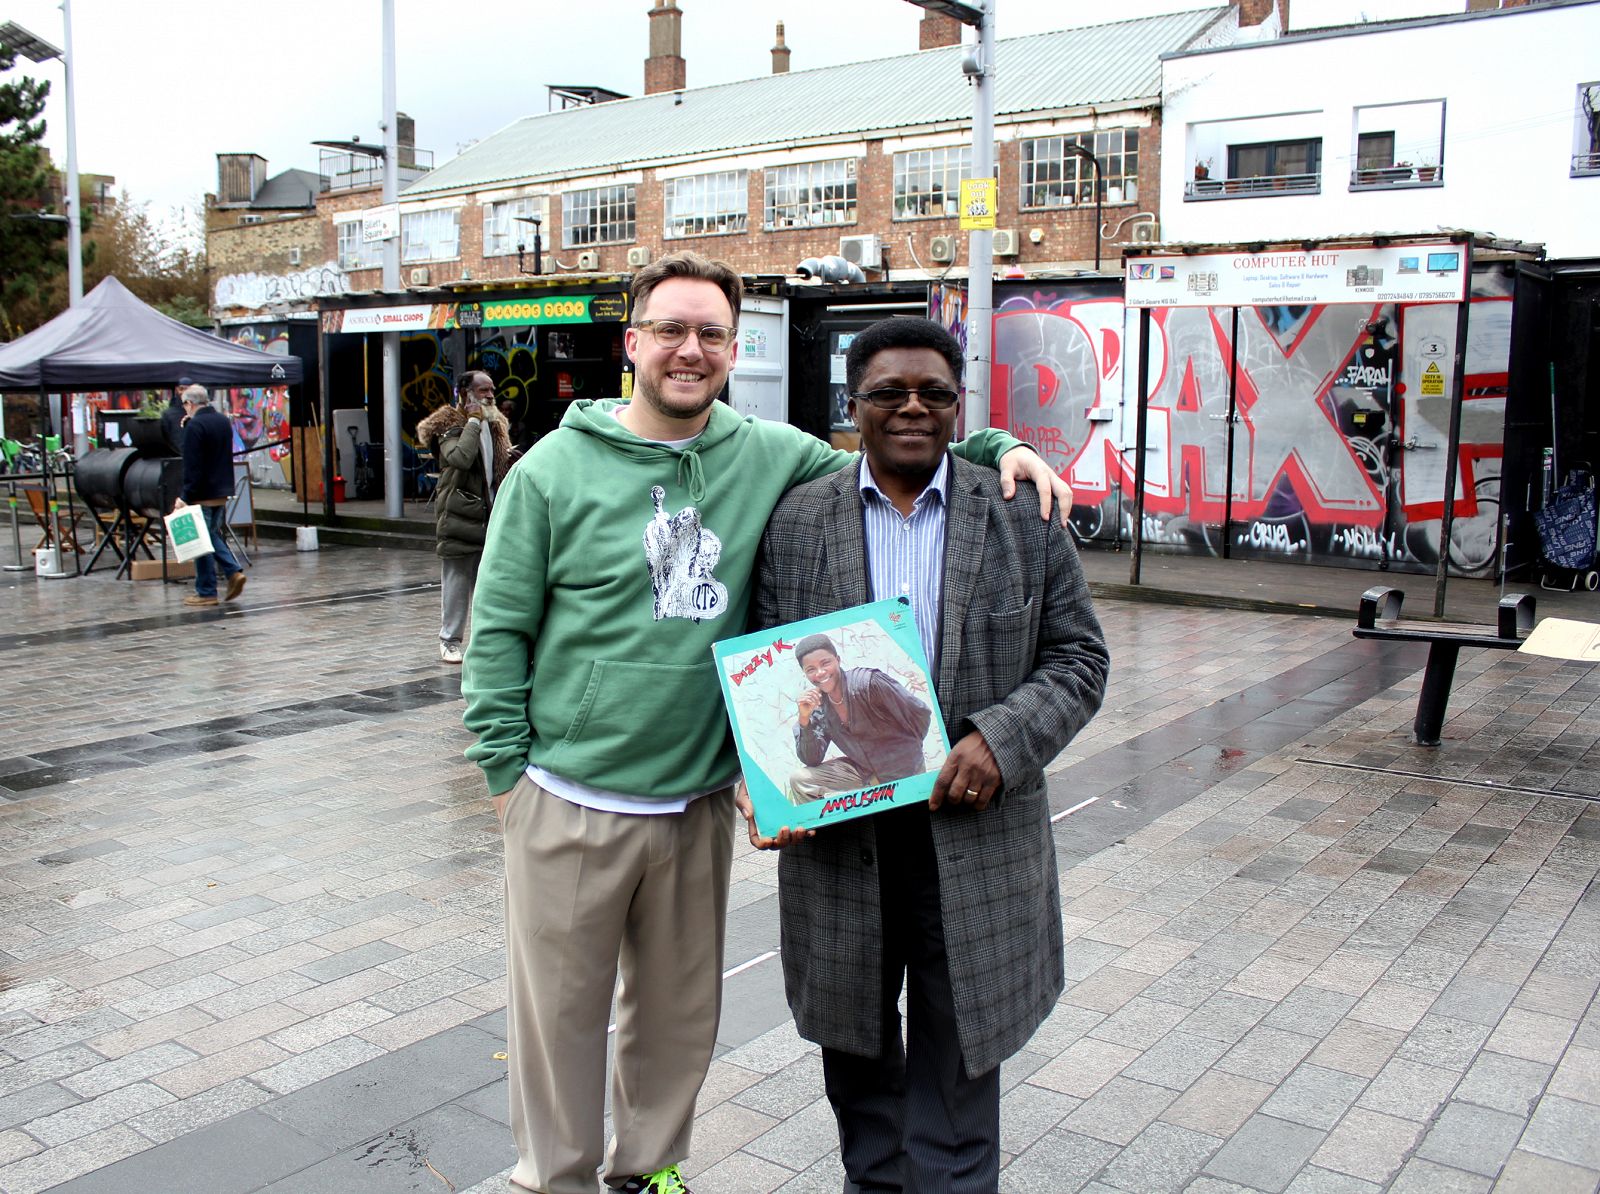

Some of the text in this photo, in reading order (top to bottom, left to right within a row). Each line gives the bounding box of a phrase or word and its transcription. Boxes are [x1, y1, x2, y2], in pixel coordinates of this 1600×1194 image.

[1233, 254, 1338, 269] COMPUTER HUT
[383, 313, 424, 323] SMALL CHOPS
[1430, 344, 1437, 352] 3
